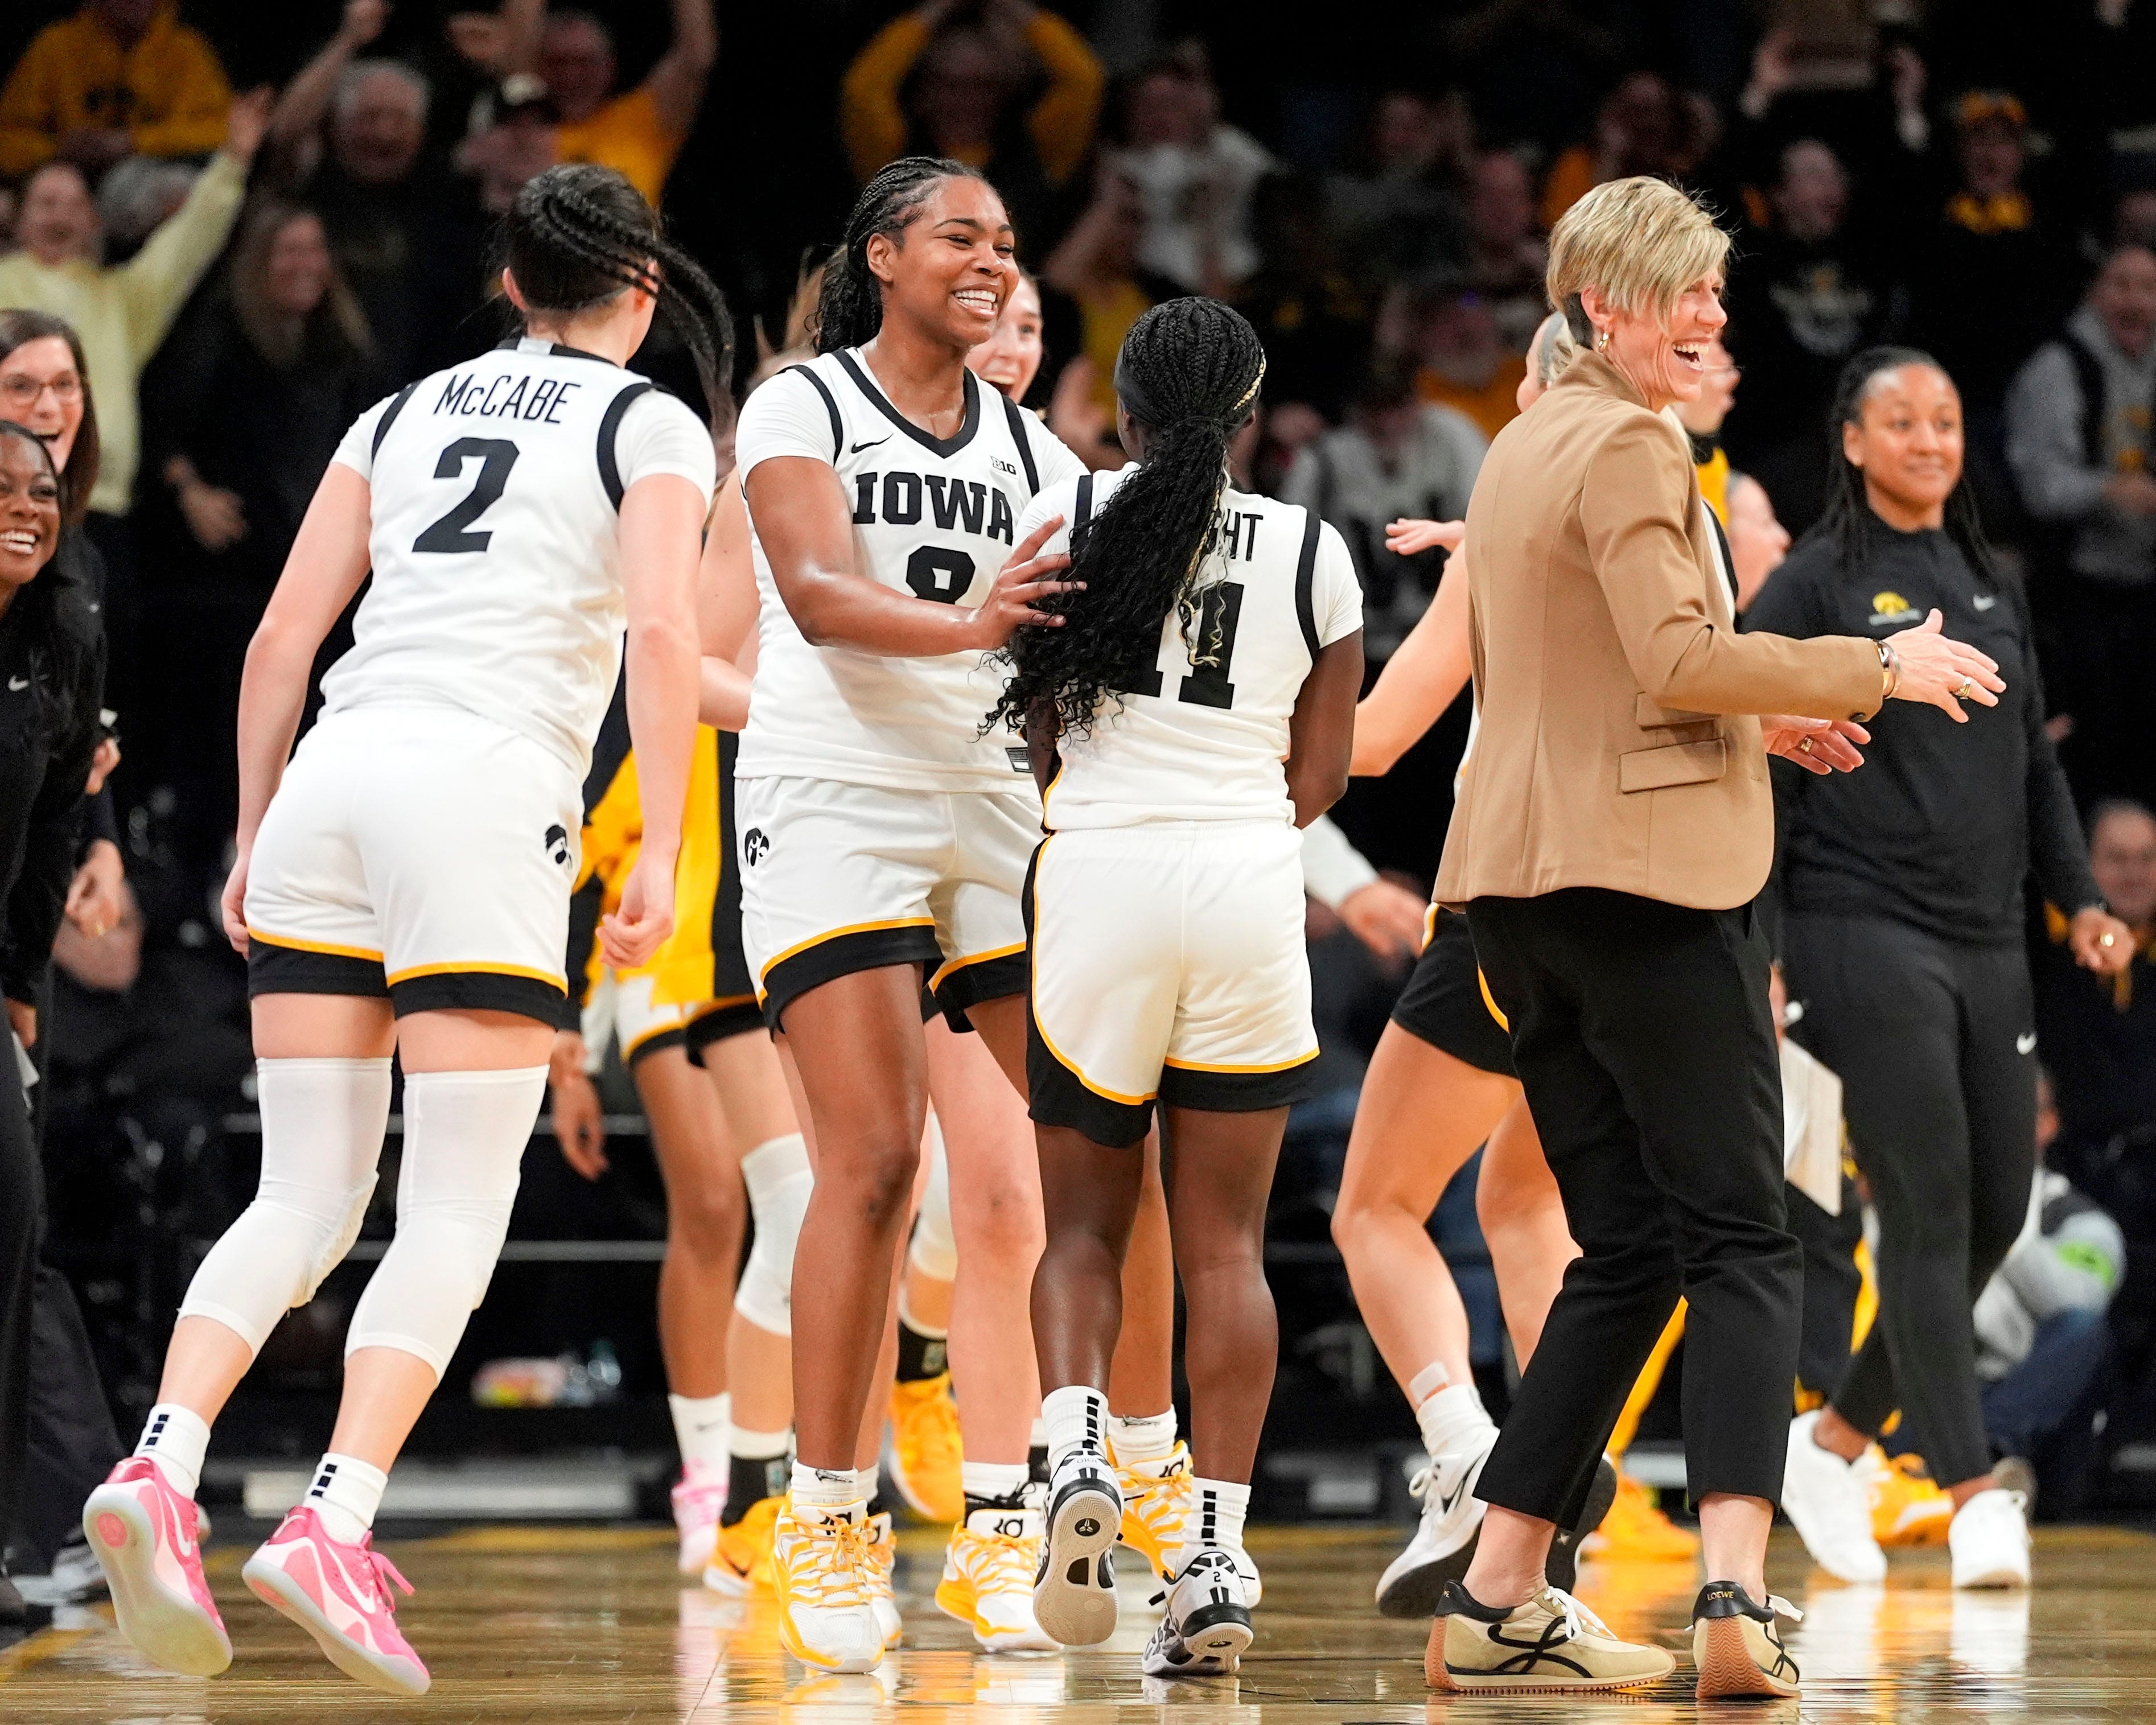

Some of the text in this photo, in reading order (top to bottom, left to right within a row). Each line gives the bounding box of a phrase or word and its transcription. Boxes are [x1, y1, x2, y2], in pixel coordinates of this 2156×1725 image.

[433, 374, 581, 423] McCABE
[412, 437, 519, 553] 2
[852, 471, 1014, 546] IOWA
[1213, 1571, 1221, 1582] 2
[1707, 1591, 1734, 1600] LOEWE
